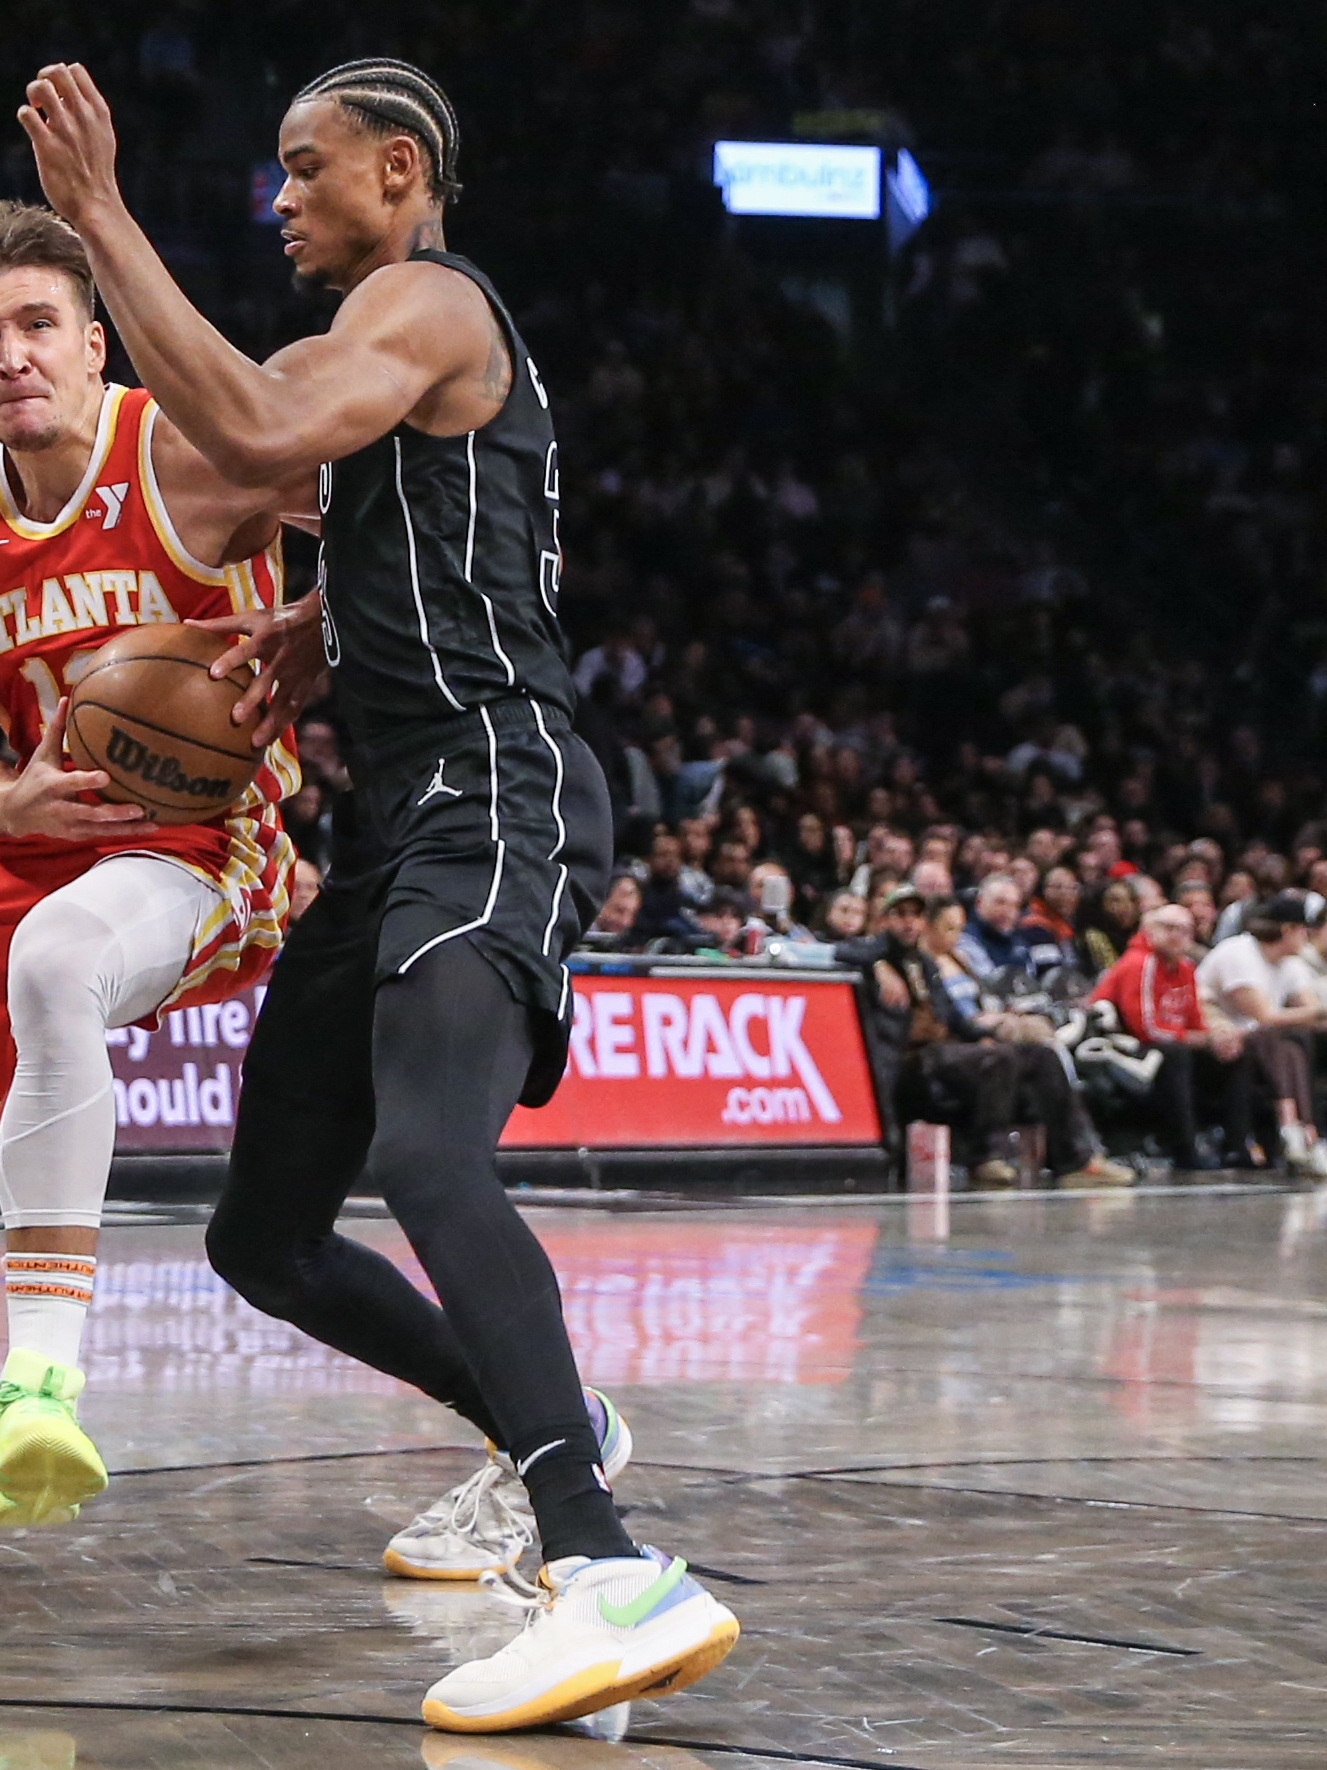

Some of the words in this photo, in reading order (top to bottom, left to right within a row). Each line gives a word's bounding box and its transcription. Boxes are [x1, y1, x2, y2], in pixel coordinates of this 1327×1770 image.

[85, 509, 102, 519] the
[19, 650, 98, 752] 1
[106, 725, 231, 797] Wilson
[640, 992, 843, 1124] RACK
[721, 1086, 813, 1125] .com
